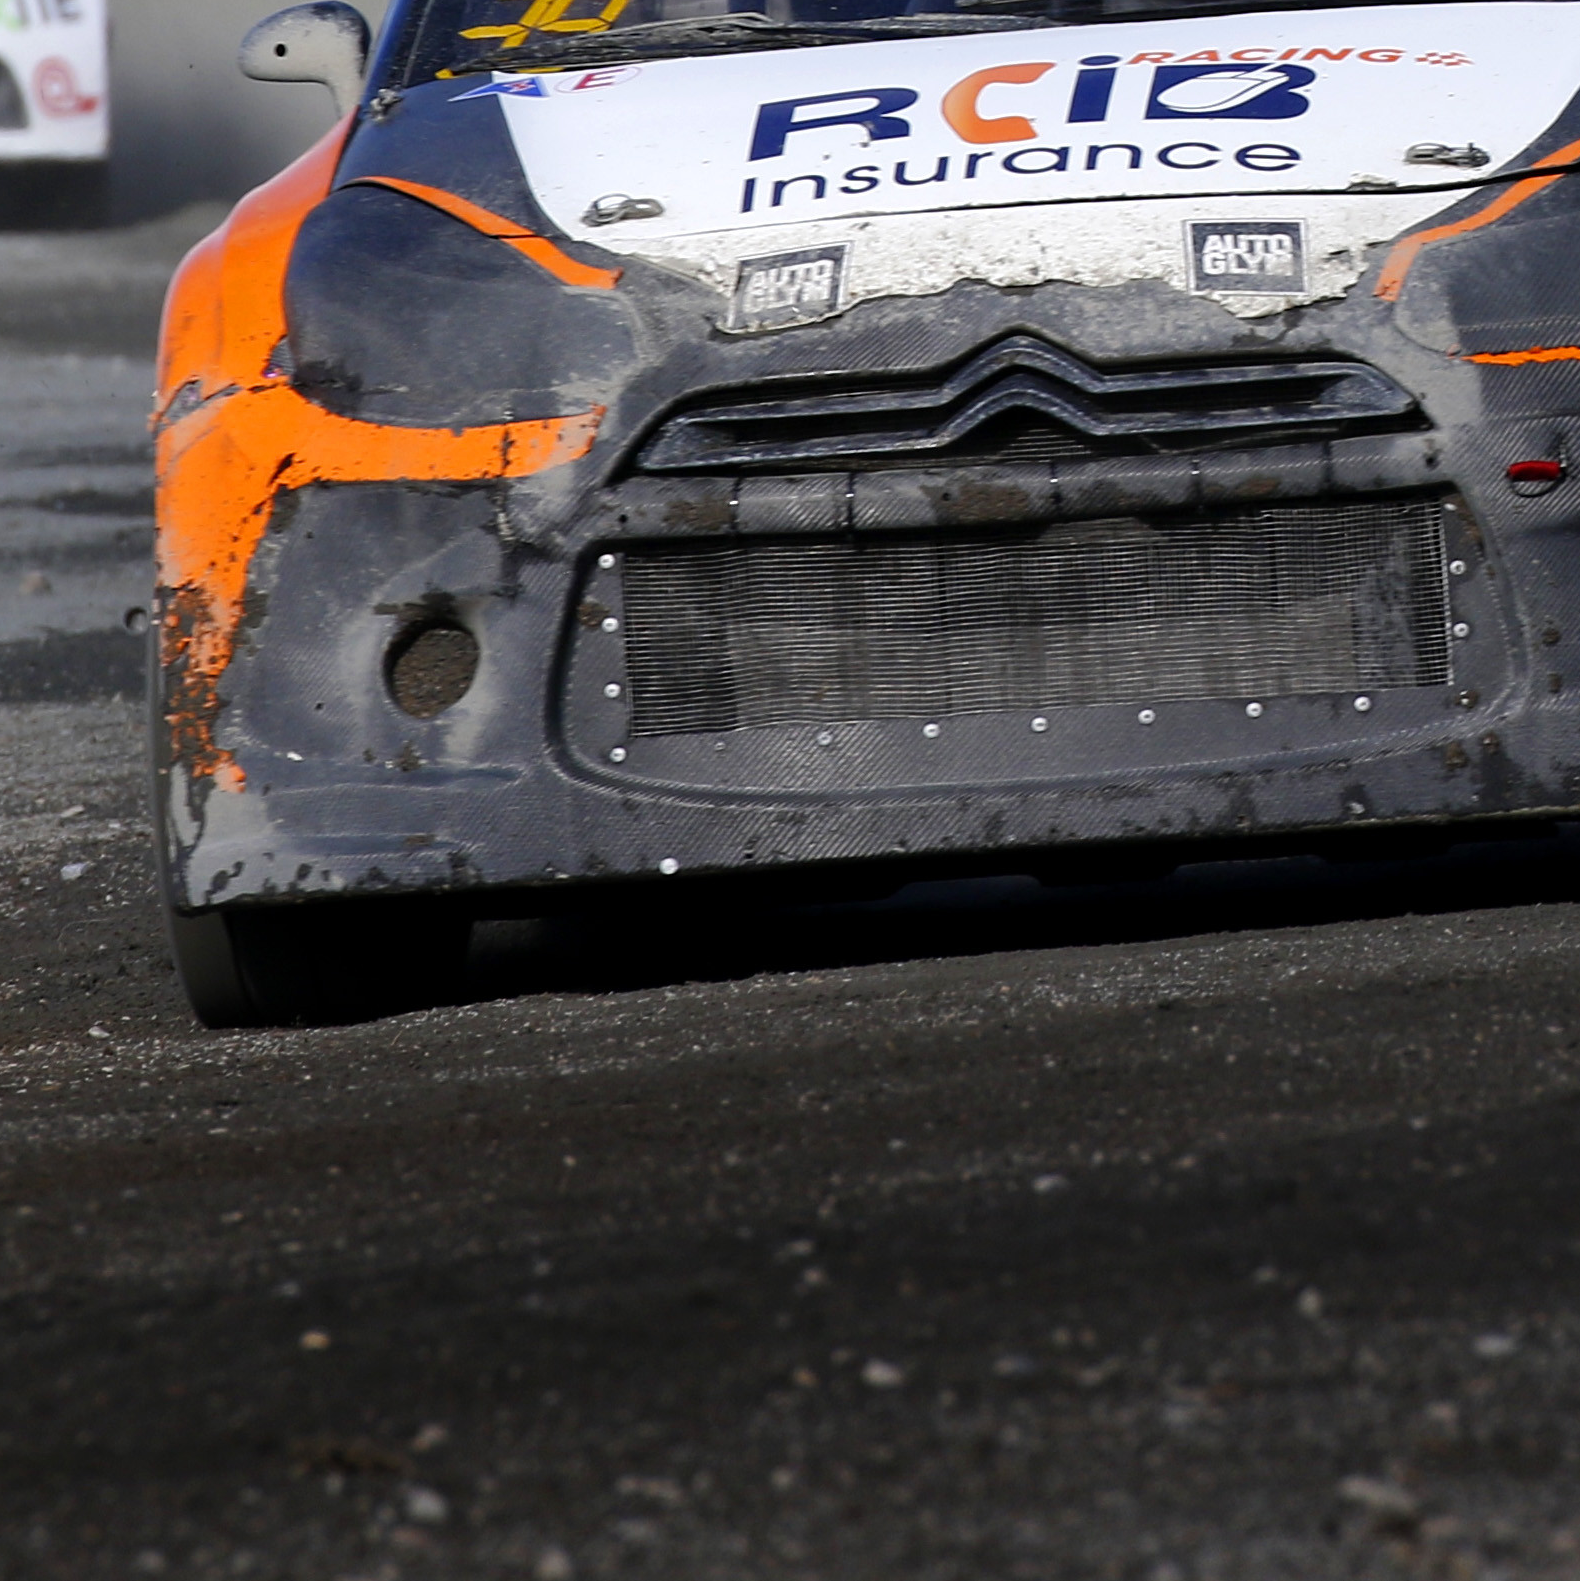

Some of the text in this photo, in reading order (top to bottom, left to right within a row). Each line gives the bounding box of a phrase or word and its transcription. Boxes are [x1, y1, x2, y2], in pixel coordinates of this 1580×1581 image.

[1127, 47, 1407, 66] RACING
[740, 141, 1302, 214] Insurance
[1202, 232, 1294, 255] AUTO
